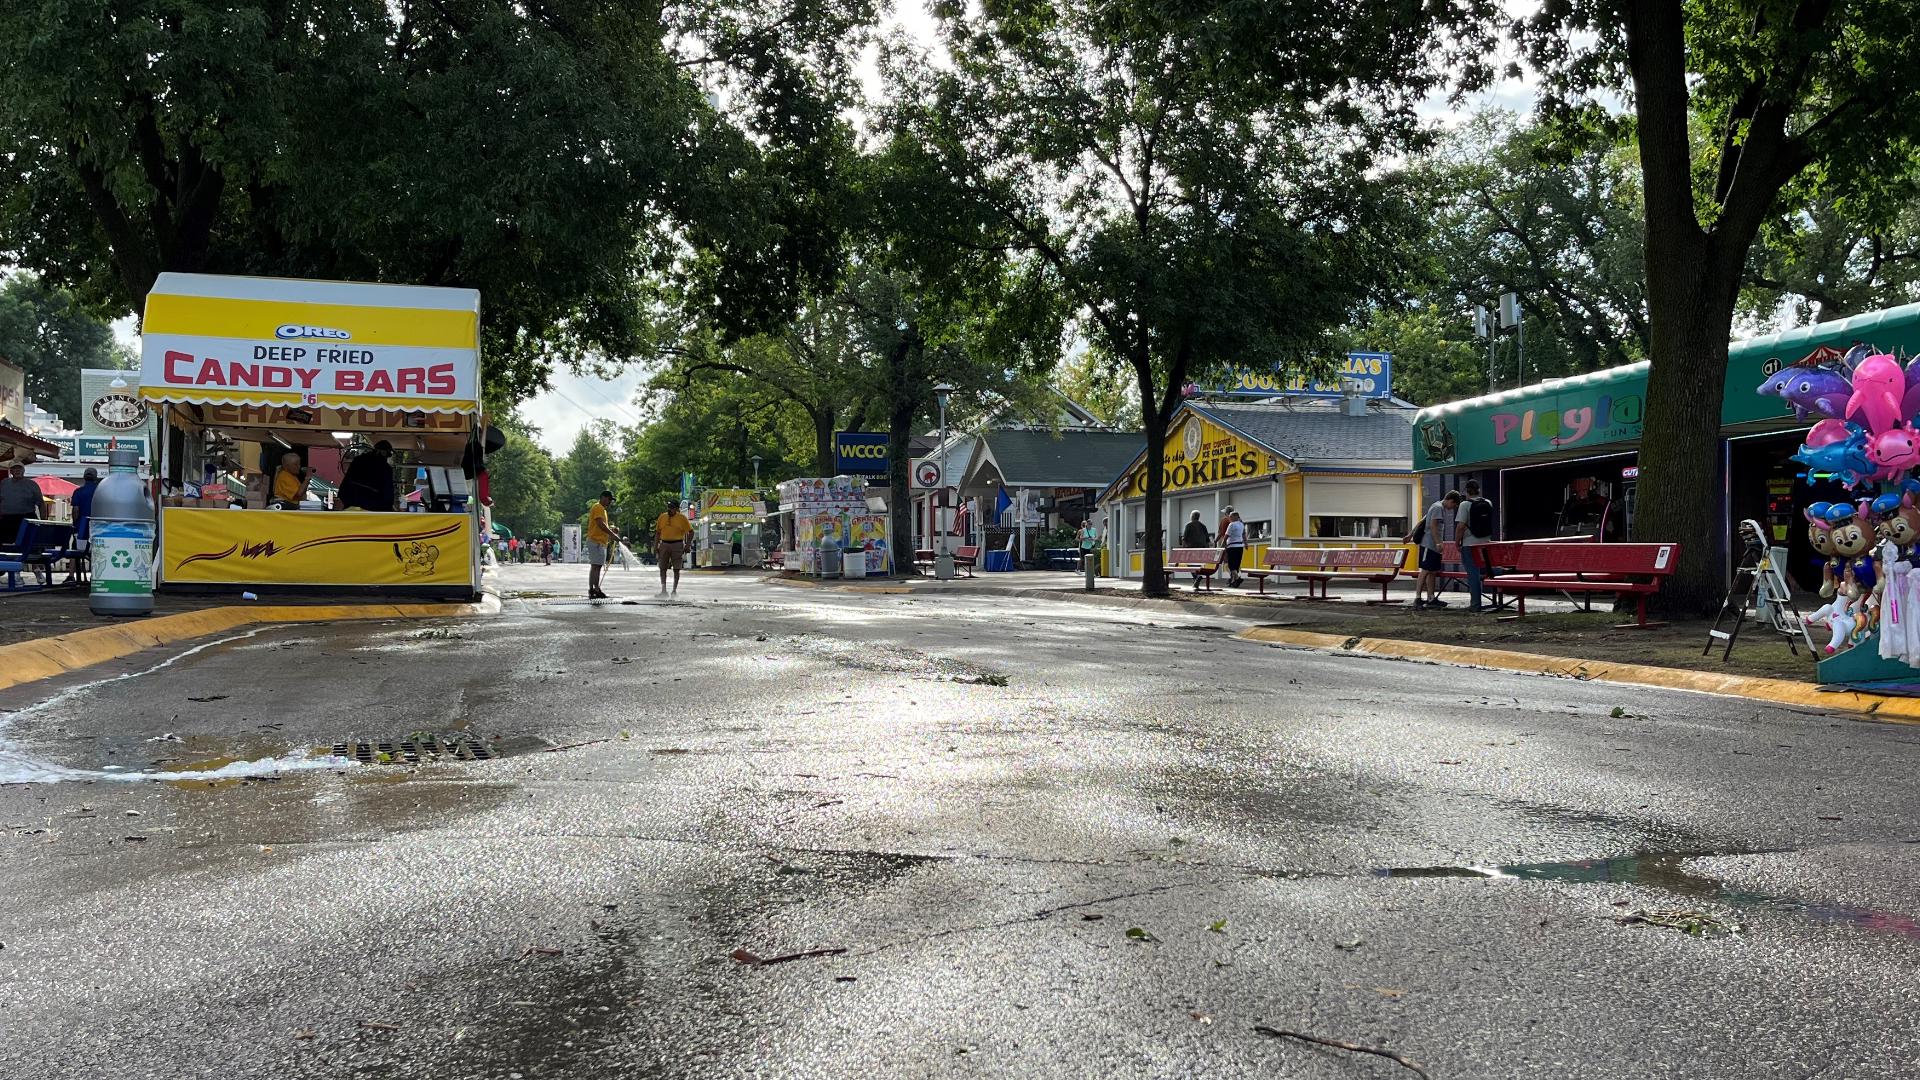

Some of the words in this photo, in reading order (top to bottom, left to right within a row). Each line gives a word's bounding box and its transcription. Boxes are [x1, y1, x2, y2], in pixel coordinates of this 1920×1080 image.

[276, 324, 351, 340] OREO
[254, 346, 306, 362] DEEP
[317, 348, 374, 365] FRIED
[164, 350, 322, 389] CANDY
[335, 362, 456, 395] BARS
[1490, 394, 1643, 445] Playla
[840, 444, 887, 459] WCCO
